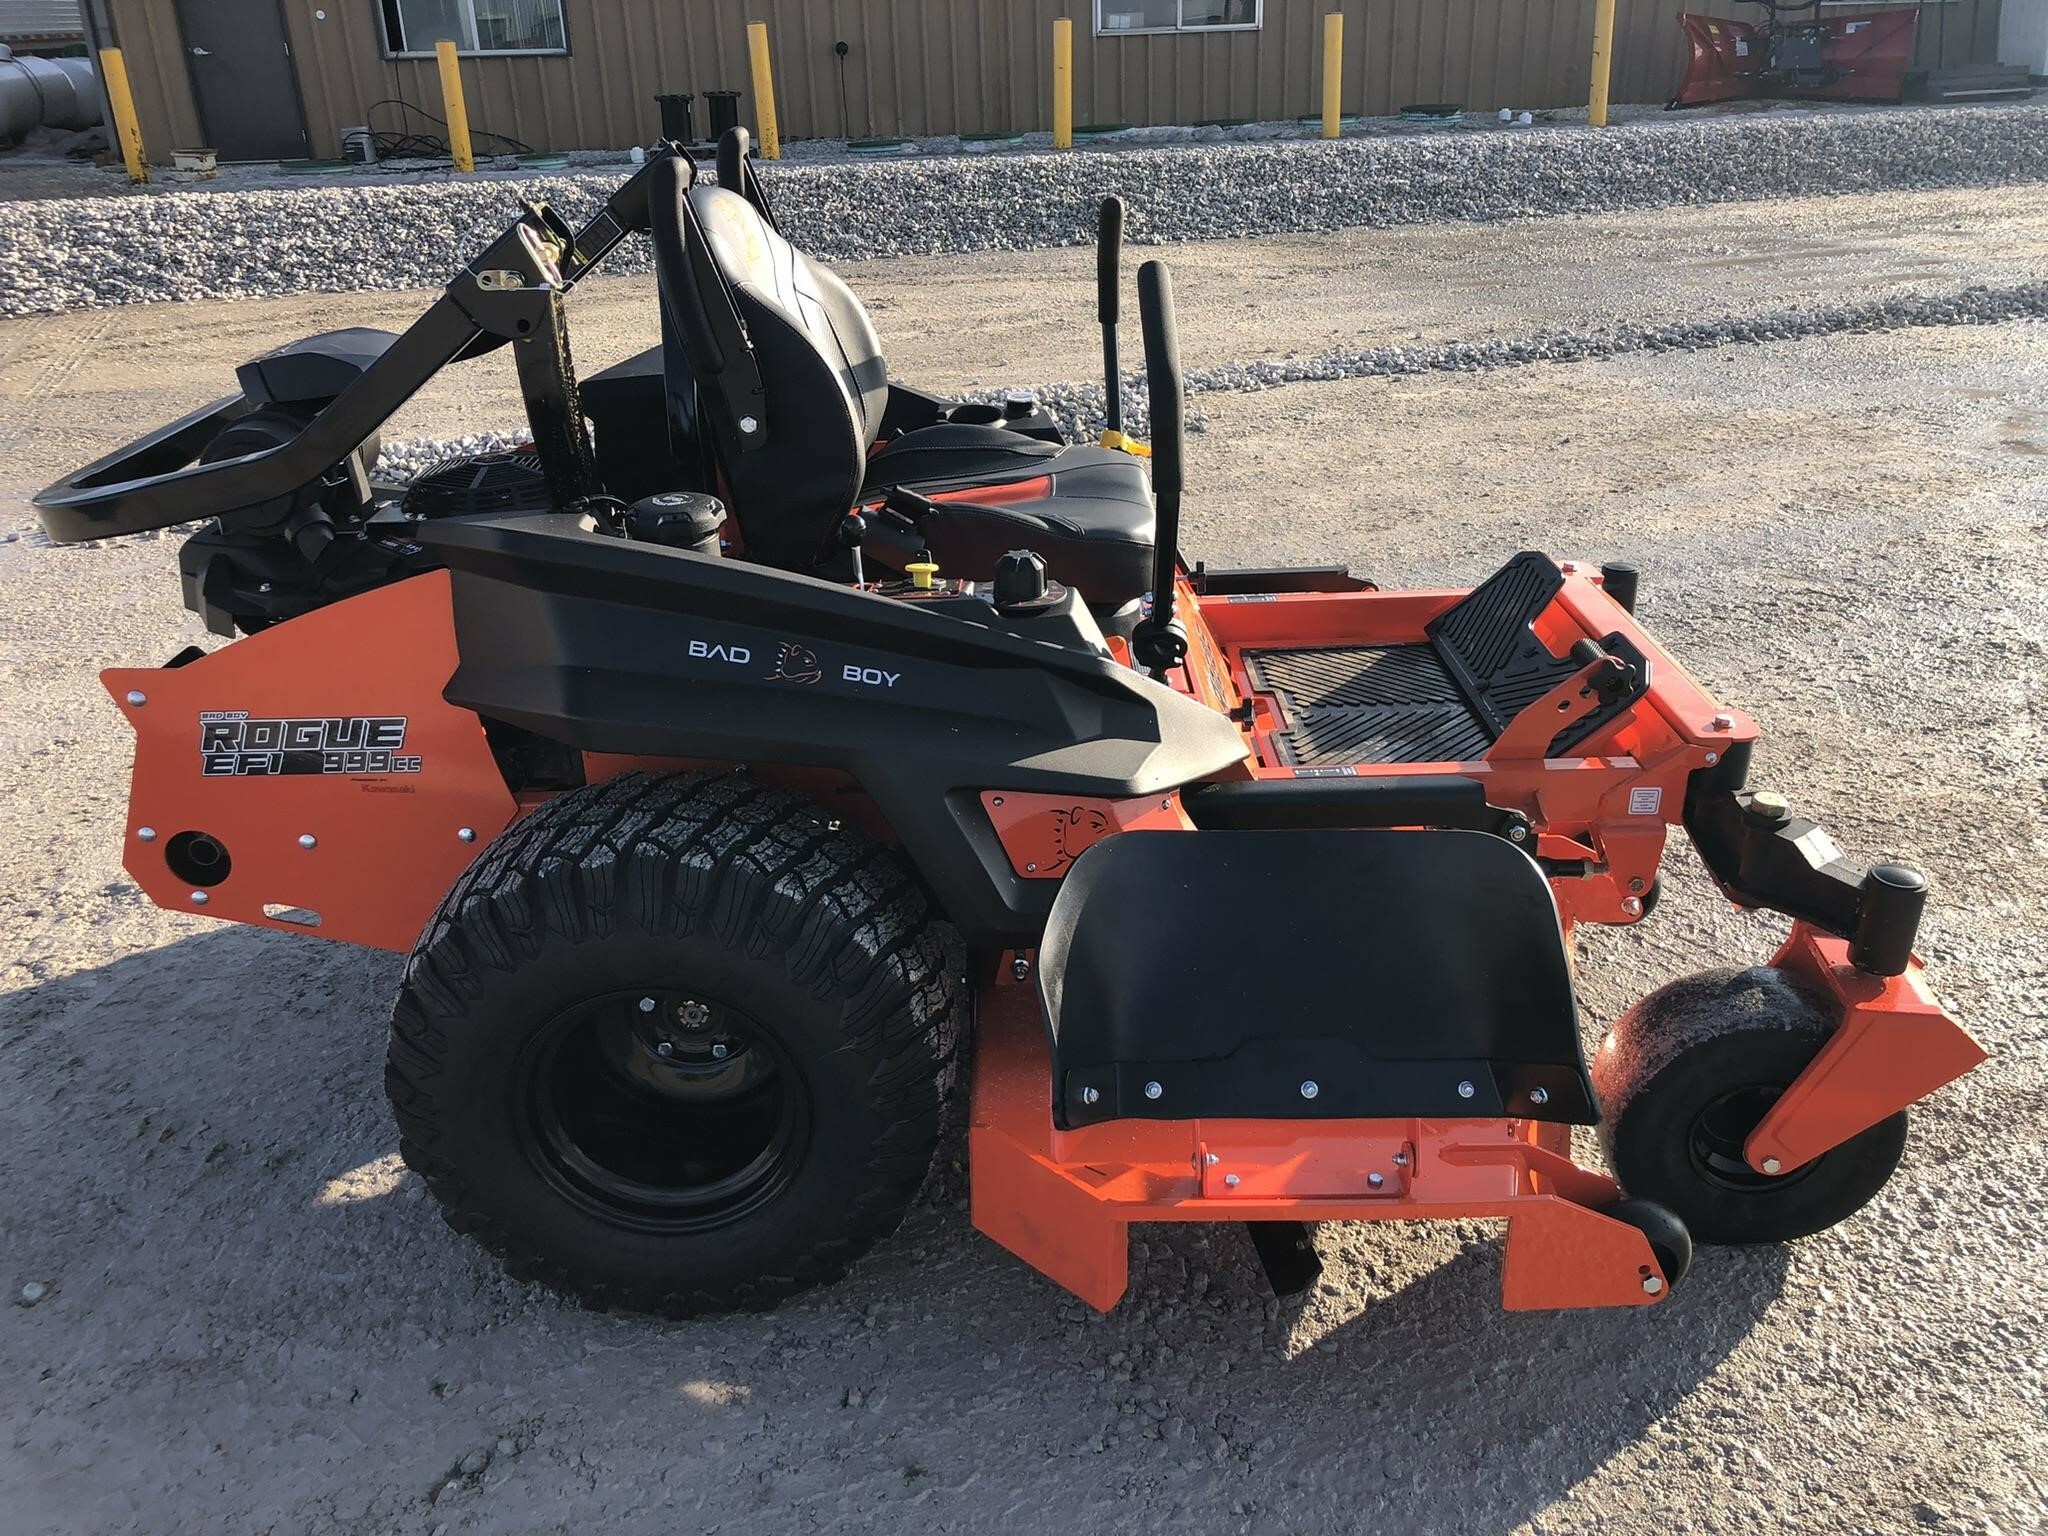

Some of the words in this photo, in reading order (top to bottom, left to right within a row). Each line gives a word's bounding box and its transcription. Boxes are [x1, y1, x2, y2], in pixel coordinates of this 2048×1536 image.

[689, 640, 751, 664] BAD
[842, 664, 901, 687] BOY
[225, 711, 248, 719] BOY
[200, 717, 407, 752] ROGUE
[202, 751, 284, 775] EFI
